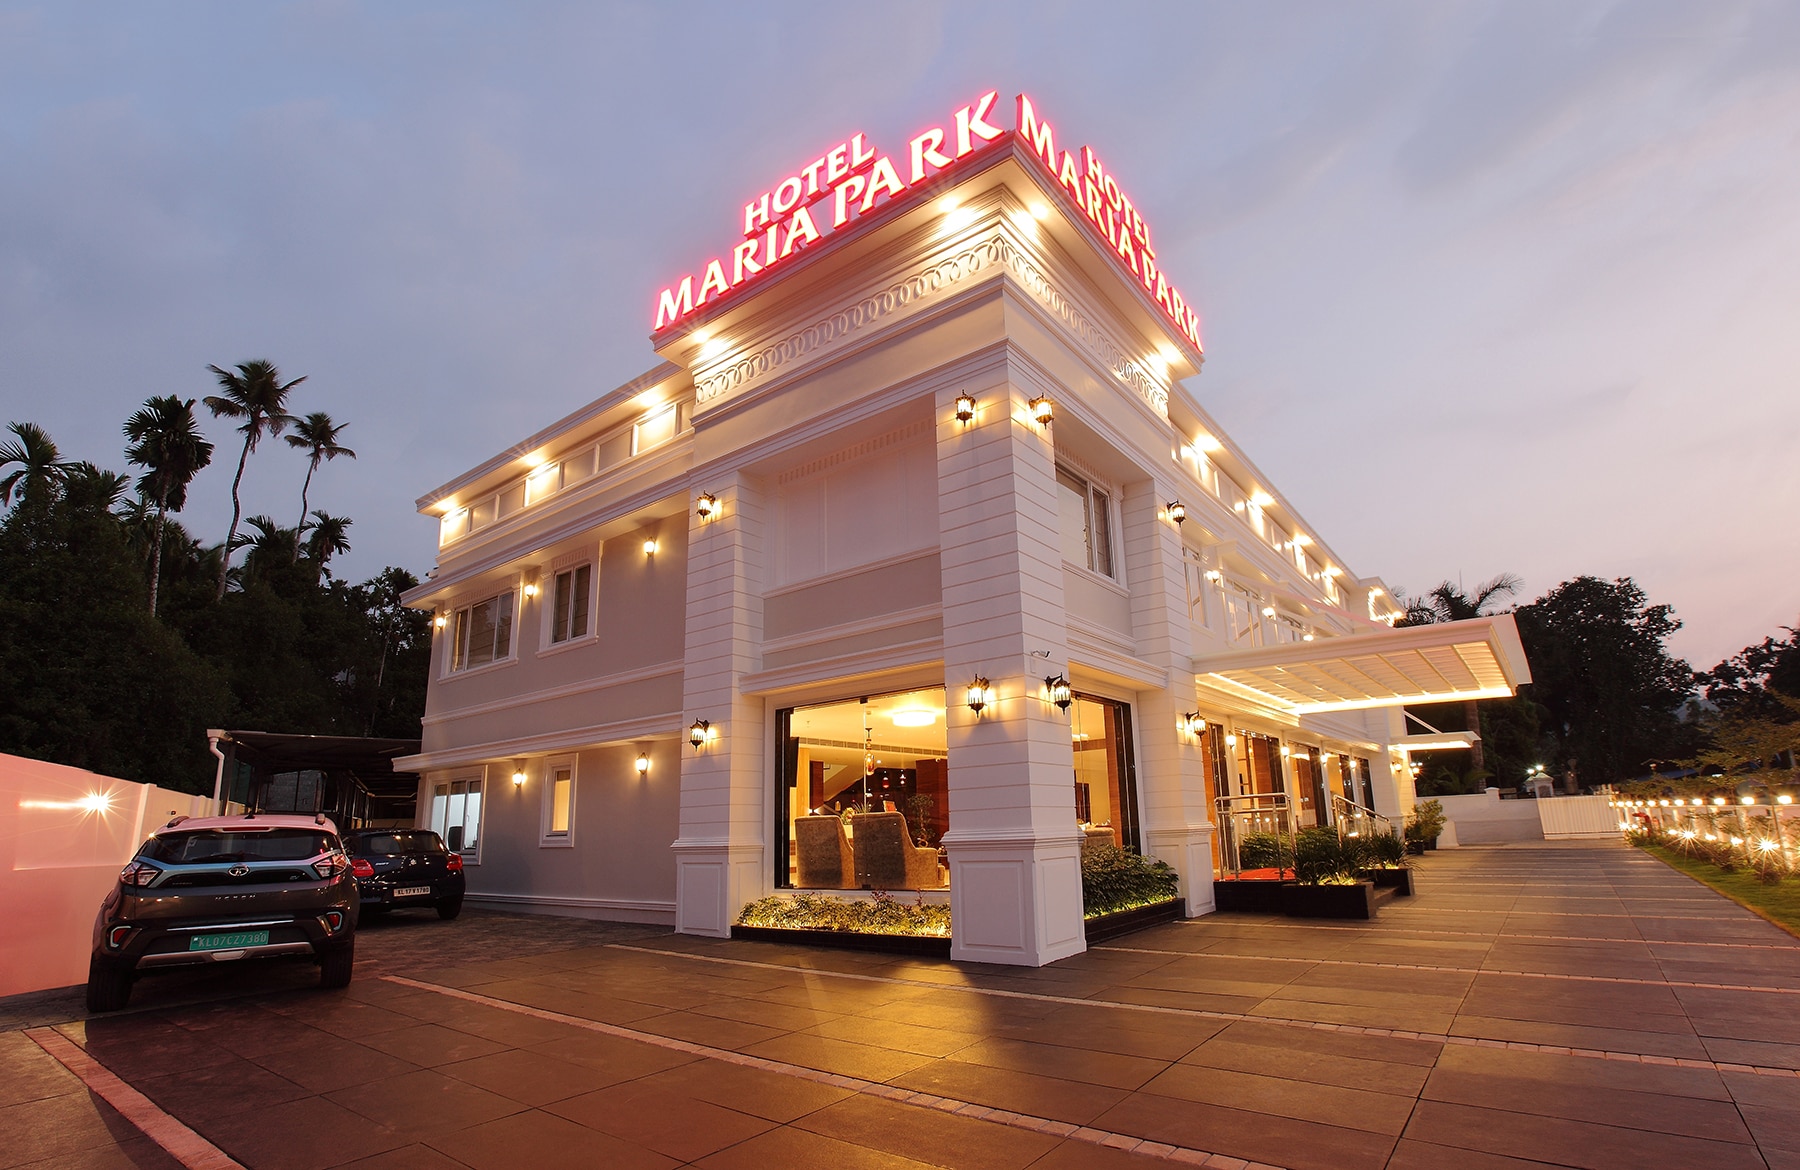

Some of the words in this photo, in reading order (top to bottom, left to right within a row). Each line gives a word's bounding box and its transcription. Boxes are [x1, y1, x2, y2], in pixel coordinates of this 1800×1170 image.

[654, 206, 824, 332] MARIA
[833, 90, 1006, 231] PARK
[744, 132, 879, 236] HOTEL
[1016, 93, 1139, 277] MARIA
[1139, 250, 1204, 354] PARK
[1080, 145, 1156, 260] HOTEL
[198, 933, 267, 947] KL07CZ7380
